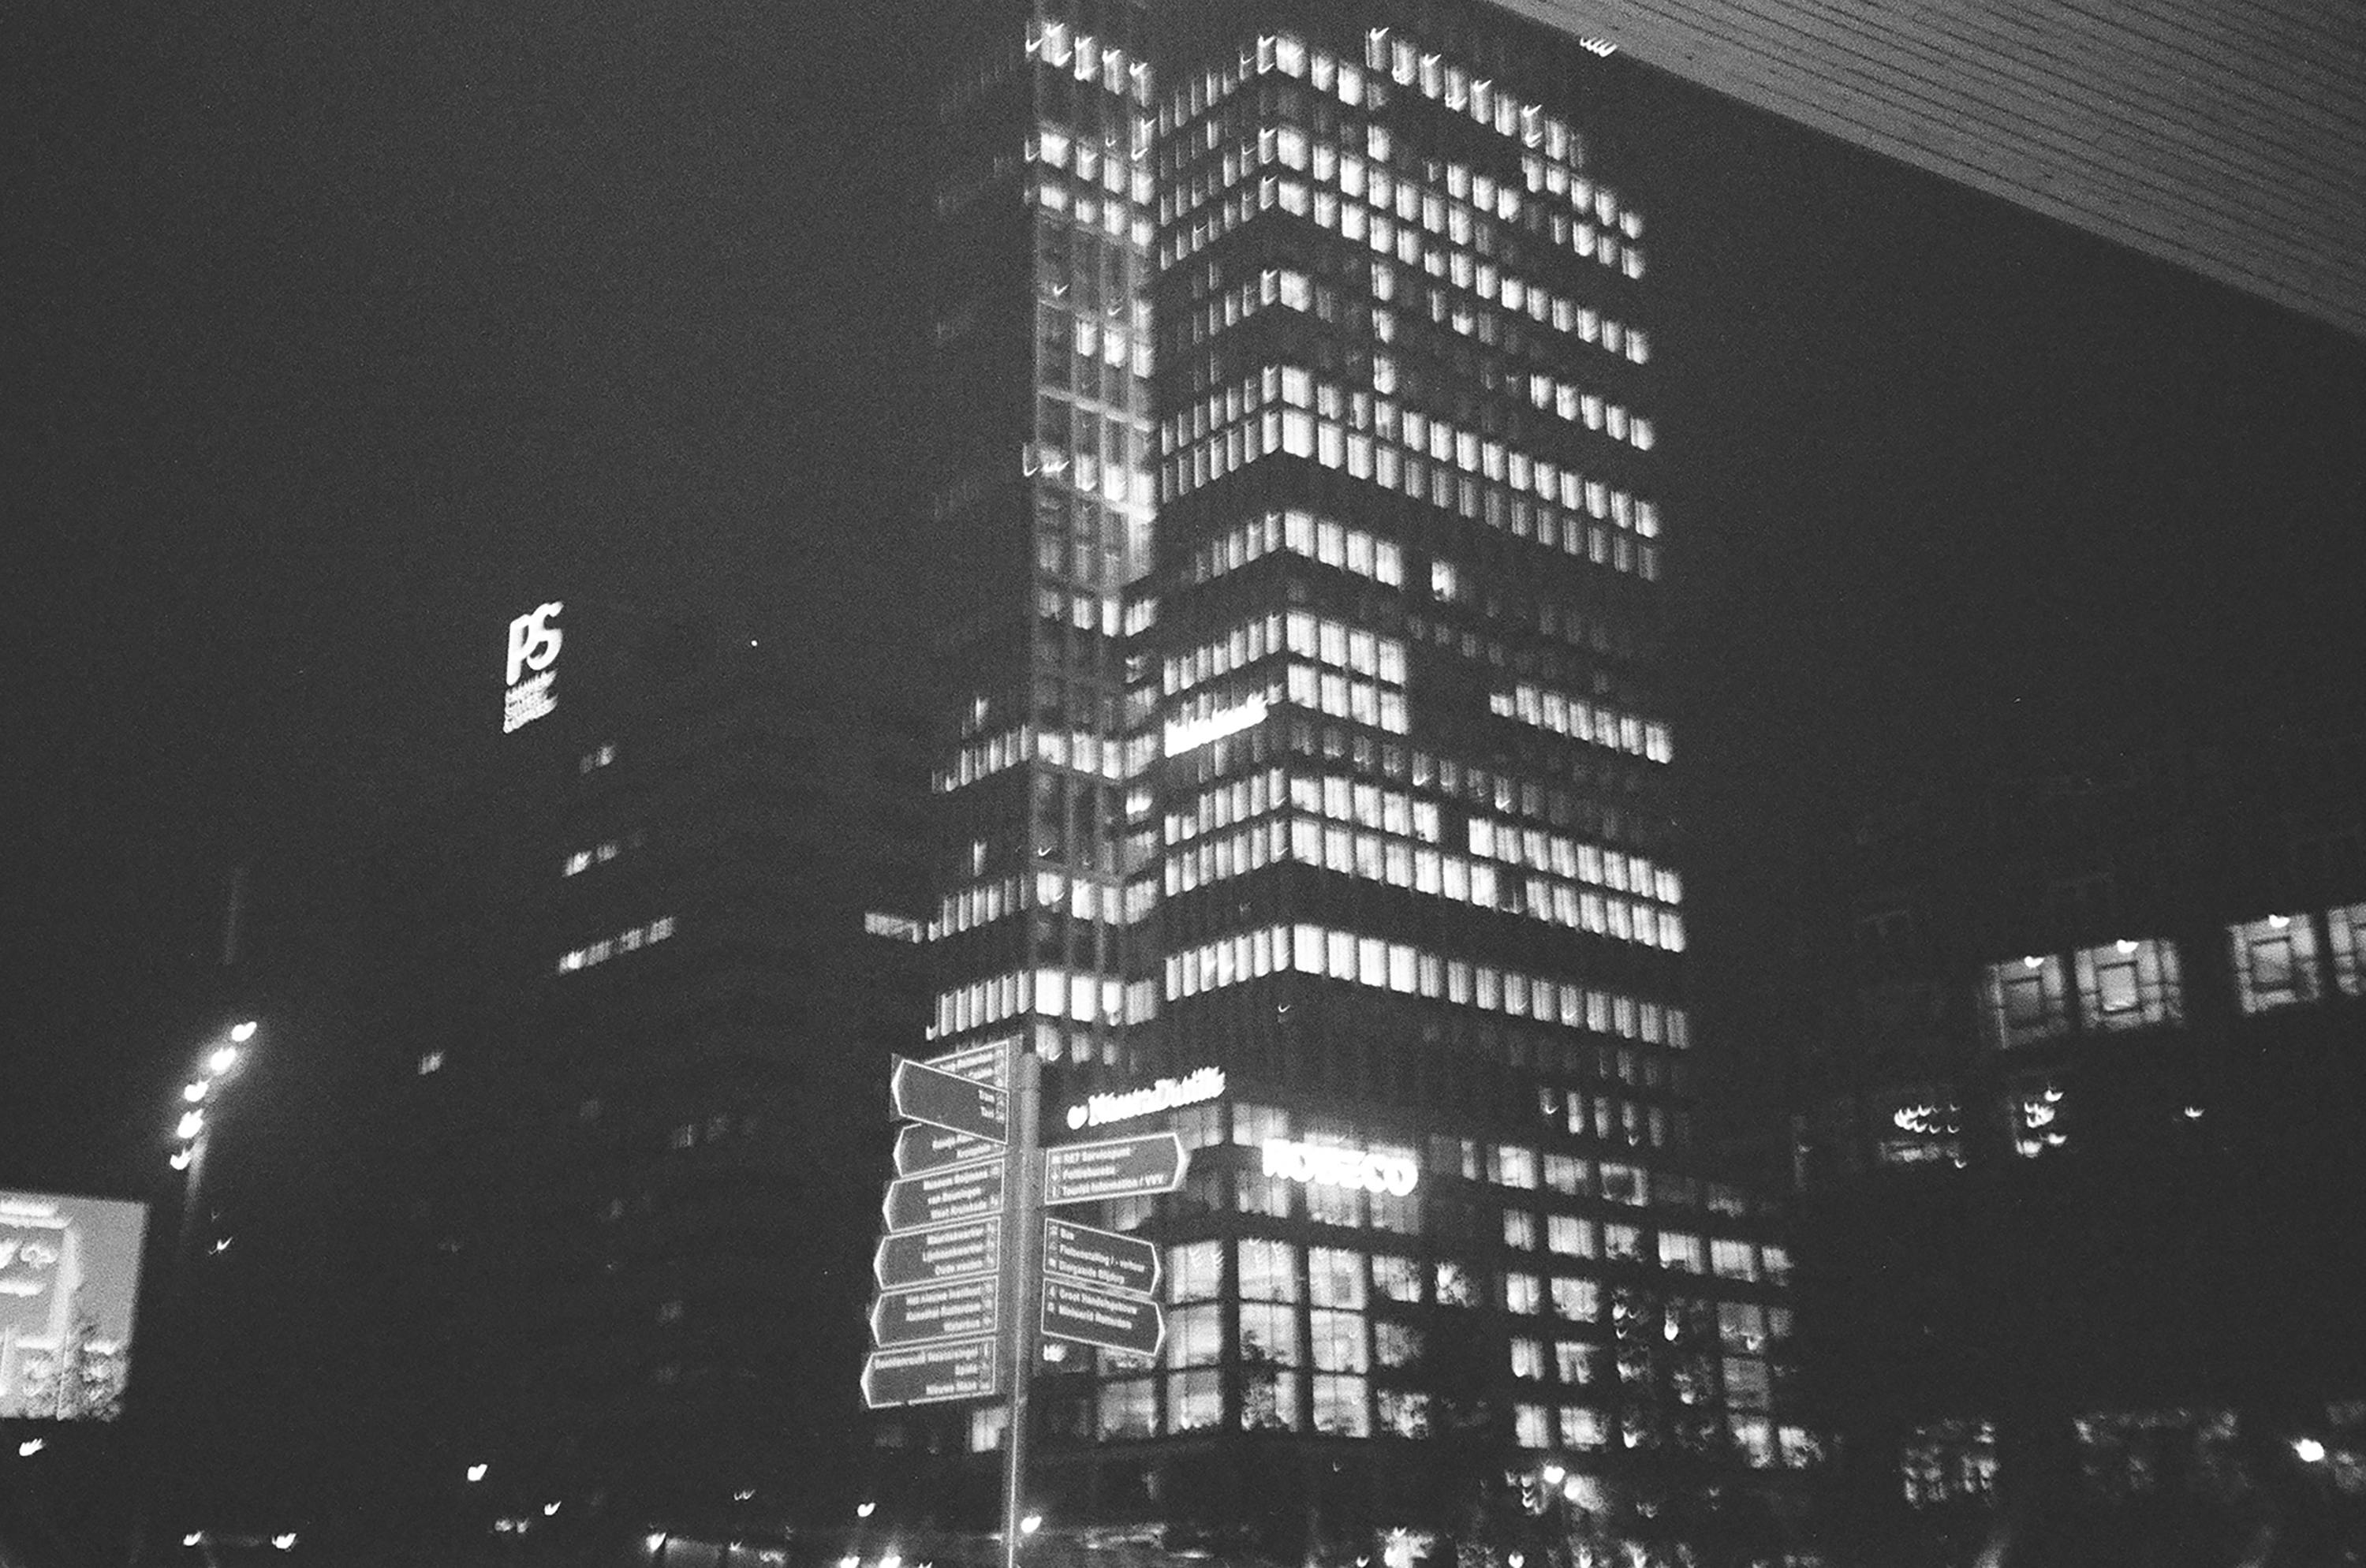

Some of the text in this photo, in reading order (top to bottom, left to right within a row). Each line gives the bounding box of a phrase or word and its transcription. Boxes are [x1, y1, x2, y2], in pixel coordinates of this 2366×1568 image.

[1262, 1139, 1418, 1197] ROBECO
[924, 1178, 953, 1190] Museum
[1063, 1183, 1090, 1197] Tourist
[1092, 1178, 1138, 1193] Information
[1145, 1174, 1164, 1185] VVV
[927, 1187, 982, 1205] van Beuningen
[1059, 1288, 1080, 1301] Groot
